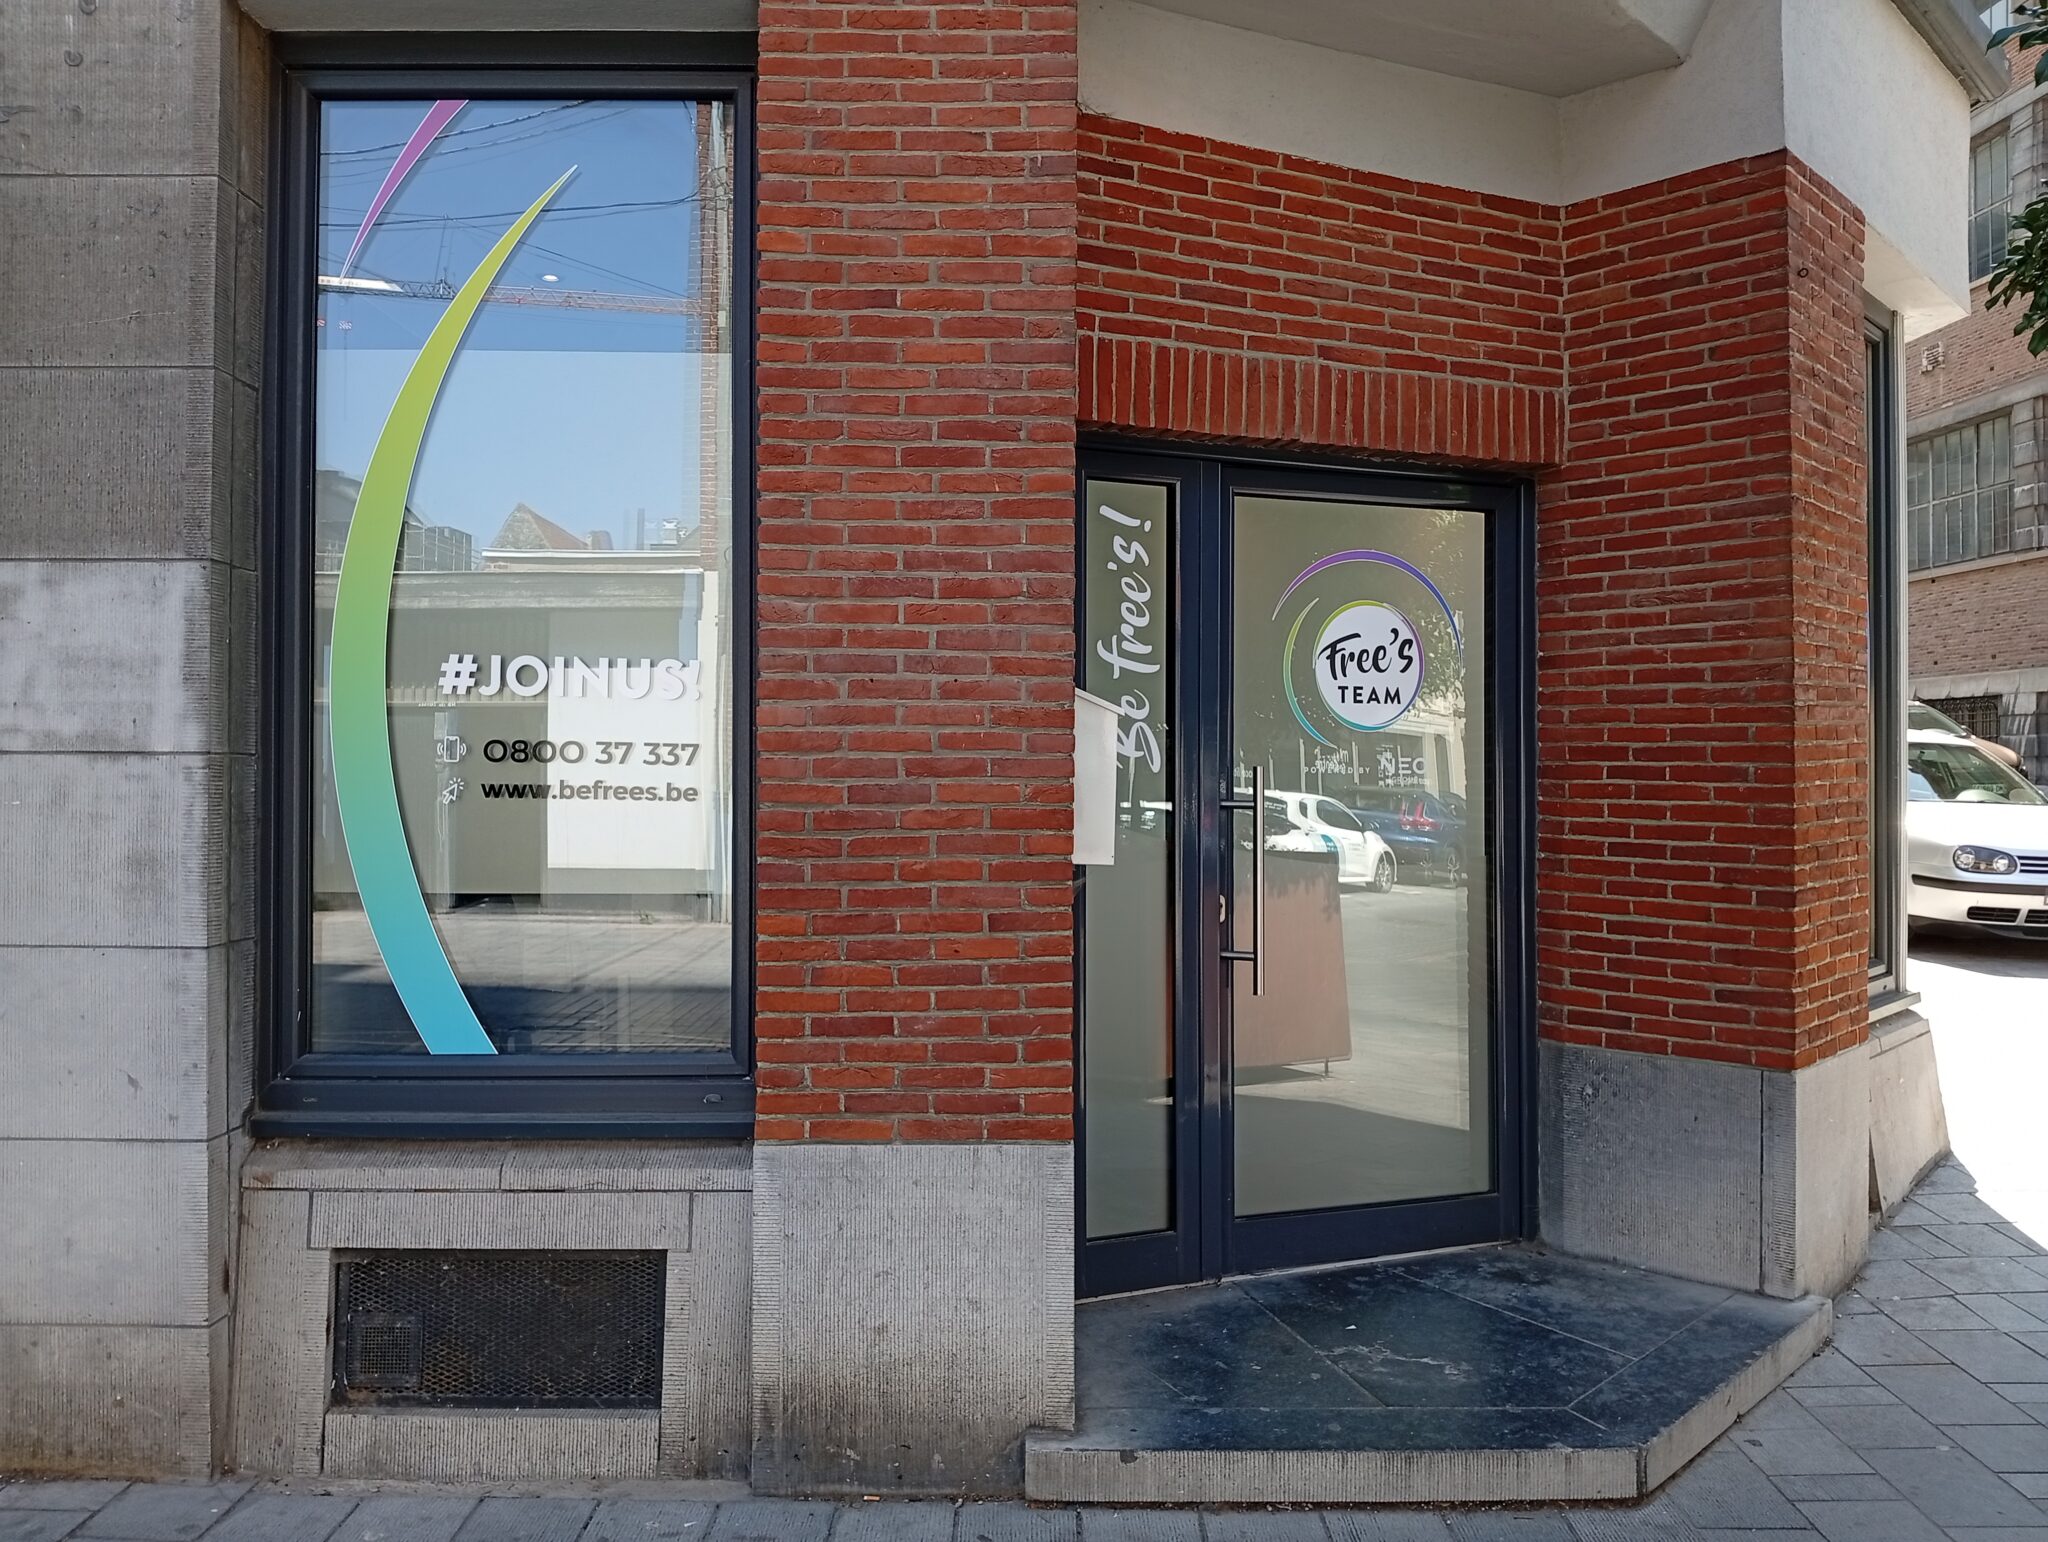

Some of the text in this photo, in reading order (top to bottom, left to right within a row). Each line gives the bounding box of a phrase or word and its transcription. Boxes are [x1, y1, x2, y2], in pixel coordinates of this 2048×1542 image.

[1097, 504, 1161, 680] free's!
[1317, 627, 1414, 681] Free's
[1337, 685, 1401, 704] TEAM
[483, 739, 700, 766] 0800 37 337
[1359, 766, 1371, 774] BY
[480, 780, 699, 802] www.befrees.be
